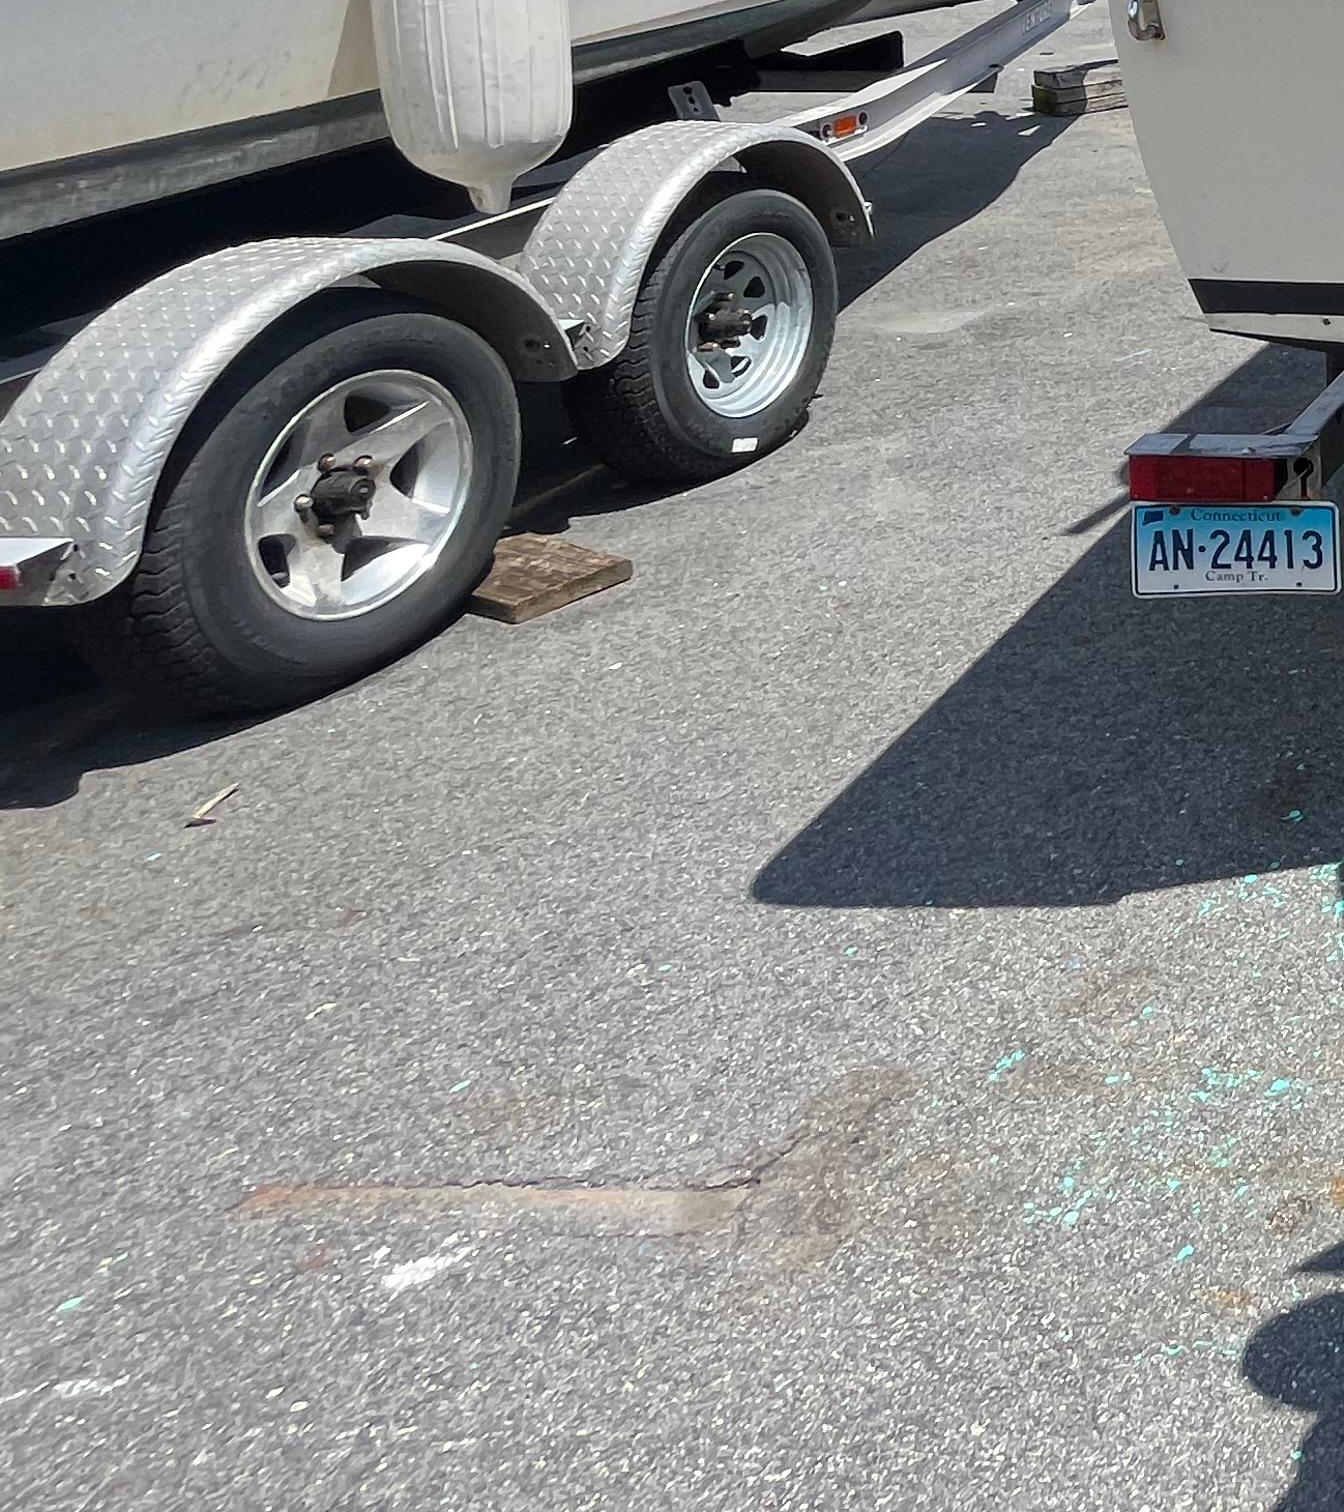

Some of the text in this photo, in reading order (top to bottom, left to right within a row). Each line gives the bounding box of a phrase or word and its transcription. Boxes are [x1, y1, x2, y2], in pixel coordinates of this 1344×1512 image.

[1190, 508, 1282, 523] Connecticut
[1204, 570, 1270, 584] Camp Tr.
